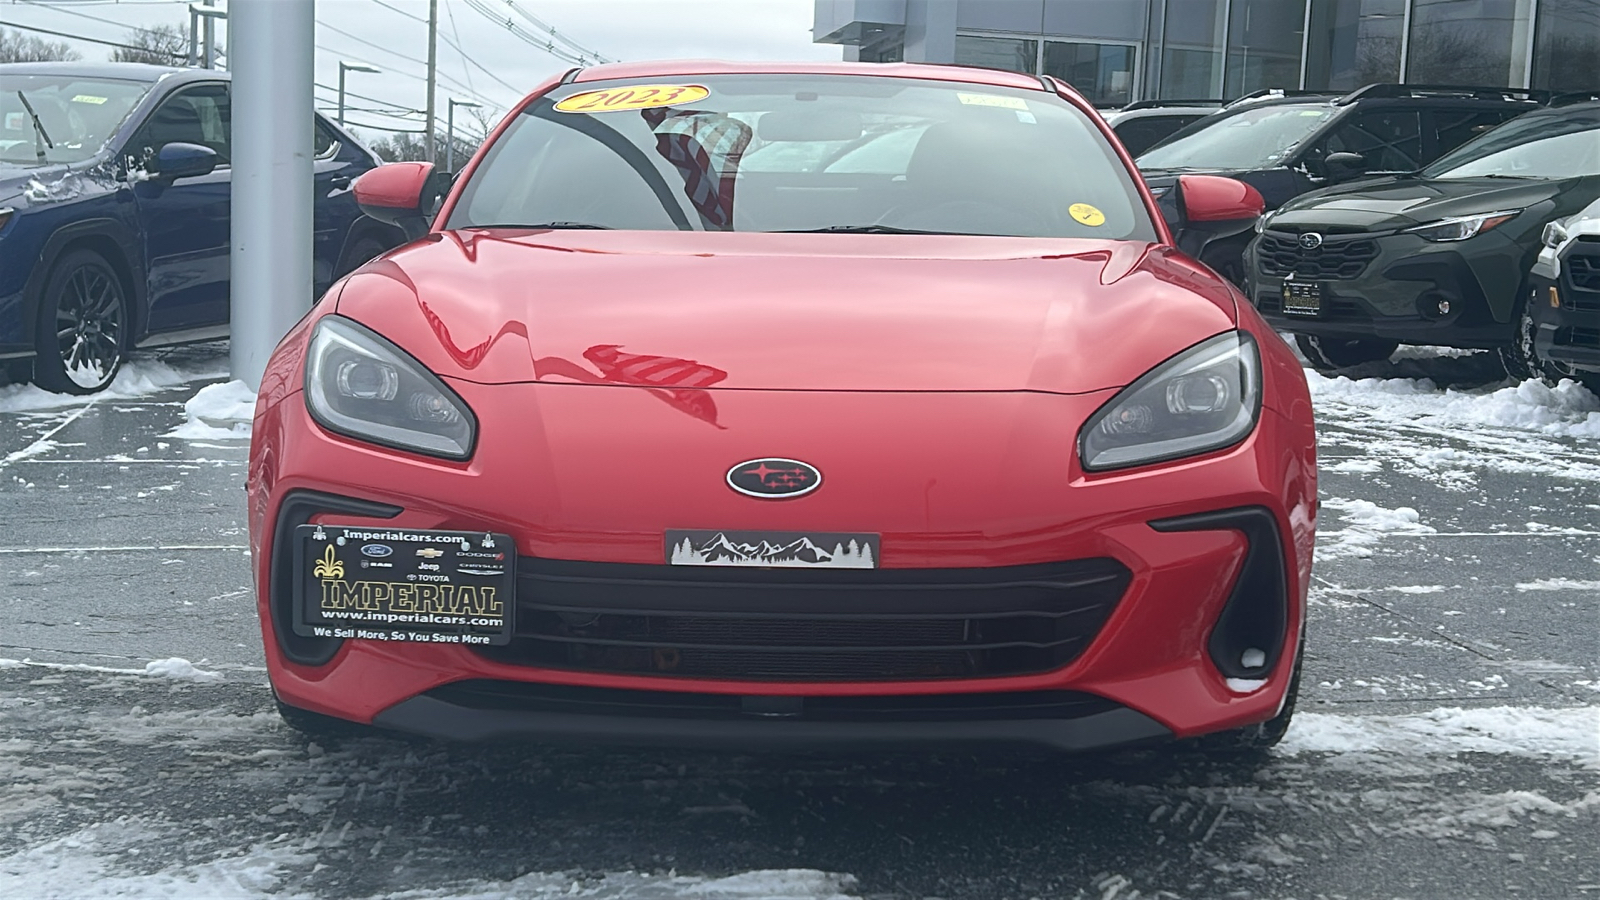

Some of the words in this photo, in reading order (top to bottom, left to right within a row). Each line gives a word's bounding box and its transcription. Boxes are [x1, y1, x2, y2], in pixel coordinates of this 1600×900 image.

[575, 87, 686, 110] 2023
[343, 529, 465, 544] Imperialcars.com
[417, 562, 440, 571] Jeep
[418, 574, 450, 582] TOYOTA
[321, 579, 503, 617] IMPERIAL
[321, 611, 503, 627] www.imperialcars.com
[314, 627, 332, 636] We
[334, 628, 354, 638] Sell
[357, 630, 389, 641] More,
[391, 631, 406, 641] So
[408, 632, 430, 642] You
[432, 633, 459, 643] Save
[462, 634, 490, 644] More
